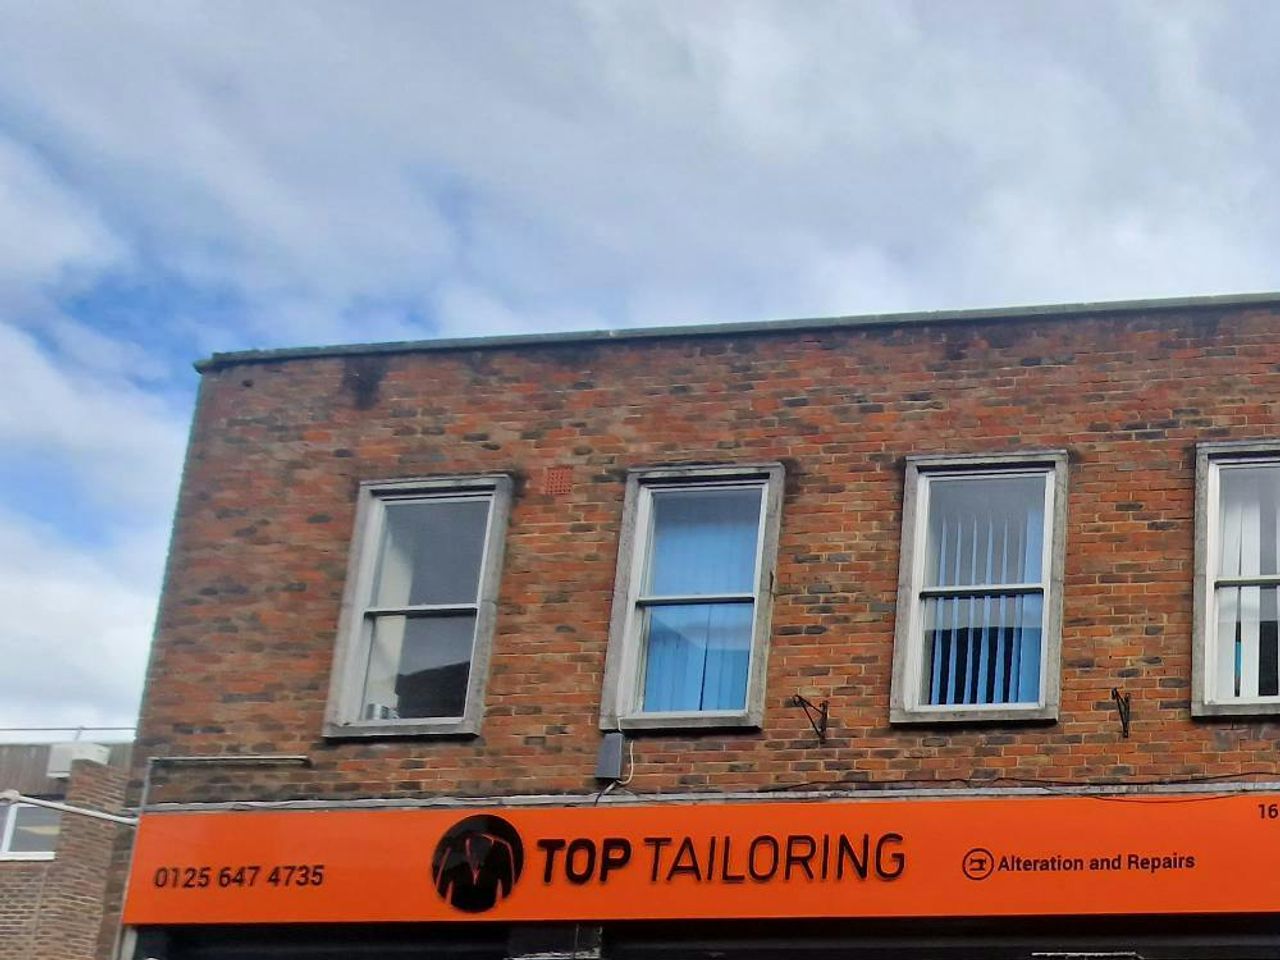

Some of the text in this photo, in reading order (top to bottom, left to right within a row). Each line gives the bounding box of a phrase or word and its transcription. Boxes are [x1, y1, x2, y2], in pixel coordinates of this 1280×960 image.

[537, 833, 905, 884] TOP TAILORING
[997, 852, 1195, 873] Alteration and Repairs
[154, 865, 324, 888] 0125 647 4735
